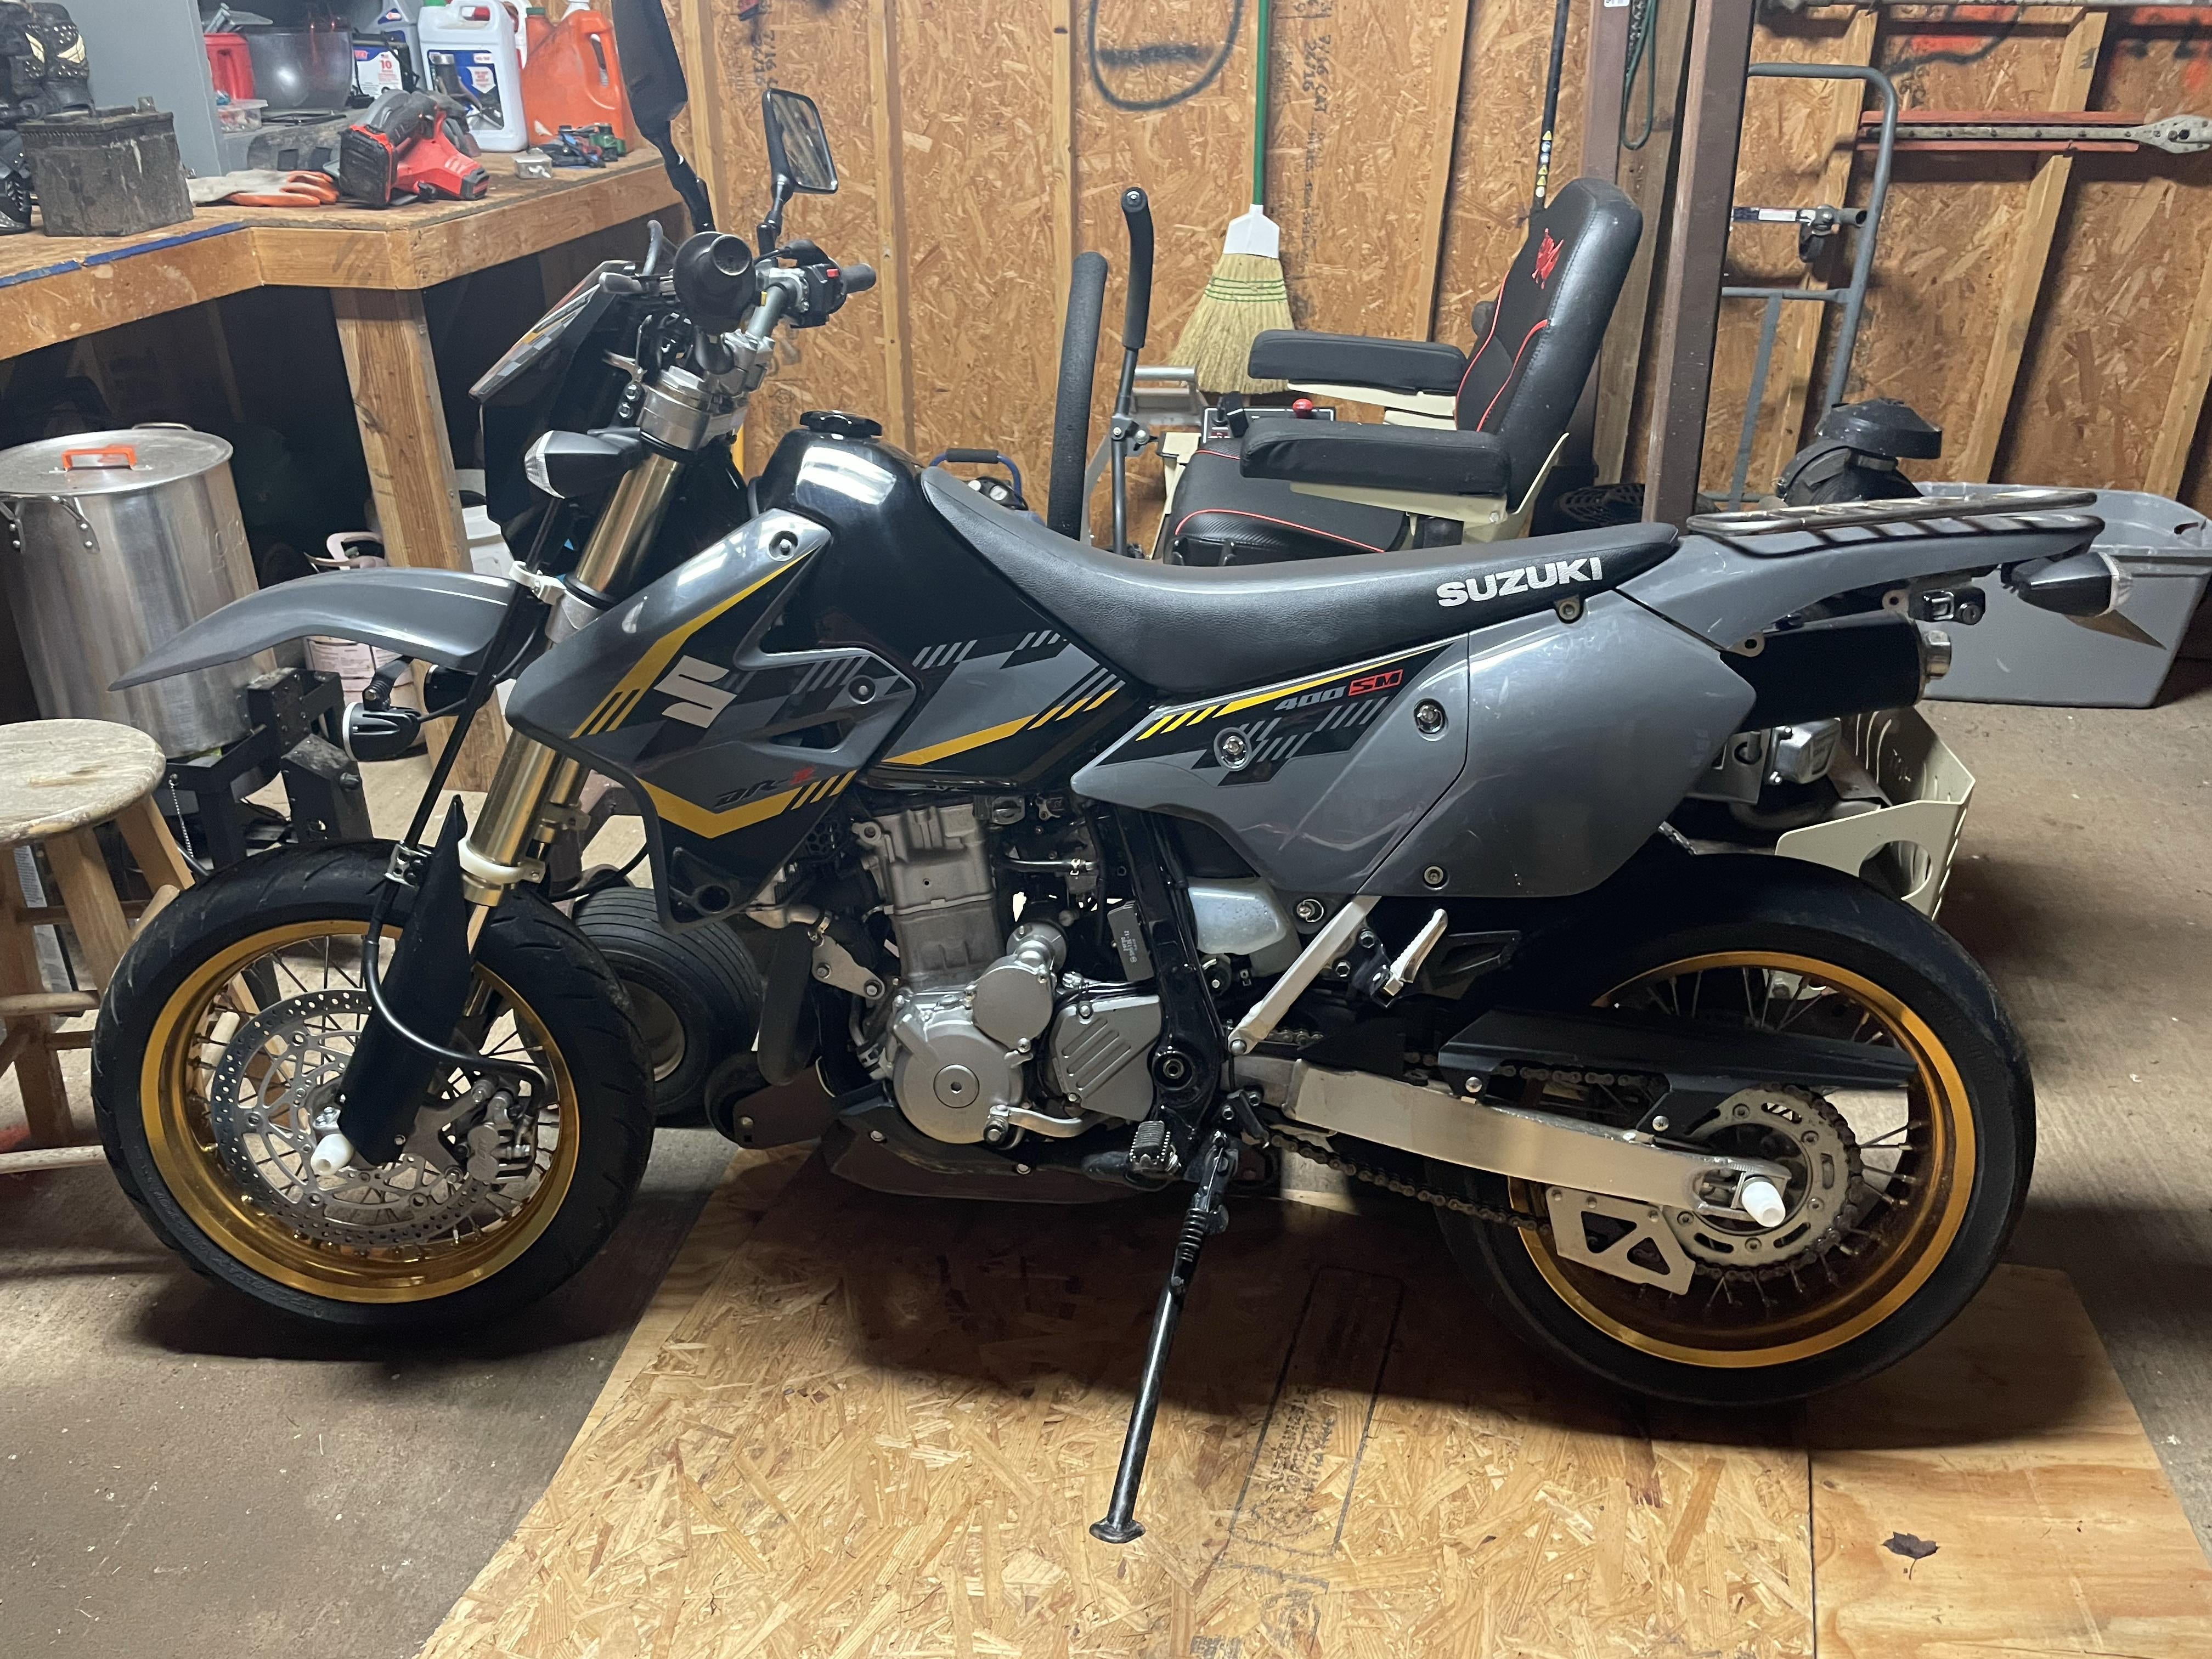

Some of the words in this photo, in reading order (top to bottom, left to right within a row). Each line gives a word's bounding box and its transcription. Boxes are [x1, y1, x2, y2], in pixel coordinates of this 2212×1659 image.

[380, 60, 392, 69] 10
[1314, 83, 1328, 114] CAT
[1436, 557, 1603, 607] SUZUKI
[1274, 685, 1347, 712] 400
[1350, 670, 1401, 695] SM
